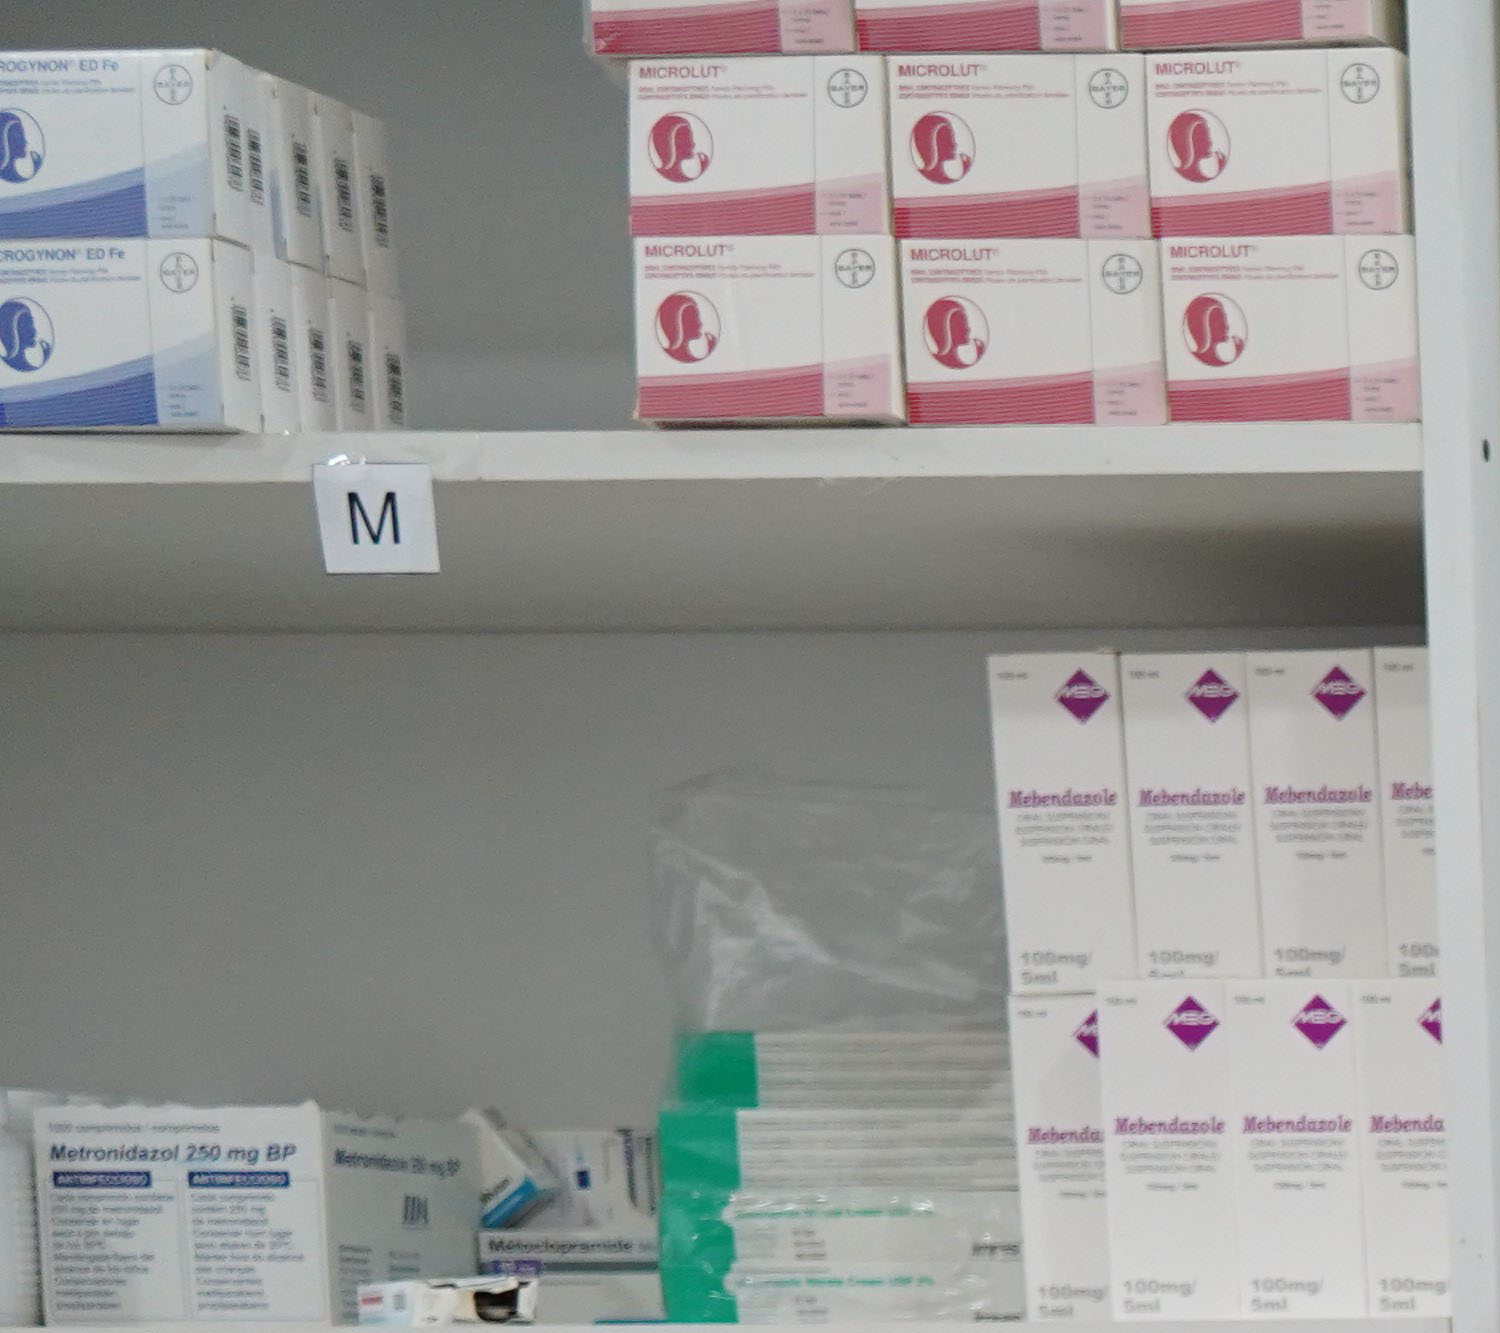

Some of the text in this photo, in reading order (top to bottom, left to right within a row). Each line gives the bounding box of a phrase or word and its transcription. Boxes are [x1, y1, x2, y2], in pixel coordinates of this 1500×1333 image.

[80, 60, 98, 71] ED
[103, 60, 119, 71] Fe
[86, 249, 105, 260] ED
[109, 249, 125, 259] Fe
[350, 491, 400, 544] M
[50, 1143, 297, 1165] Metronidazol 250 mg BP
